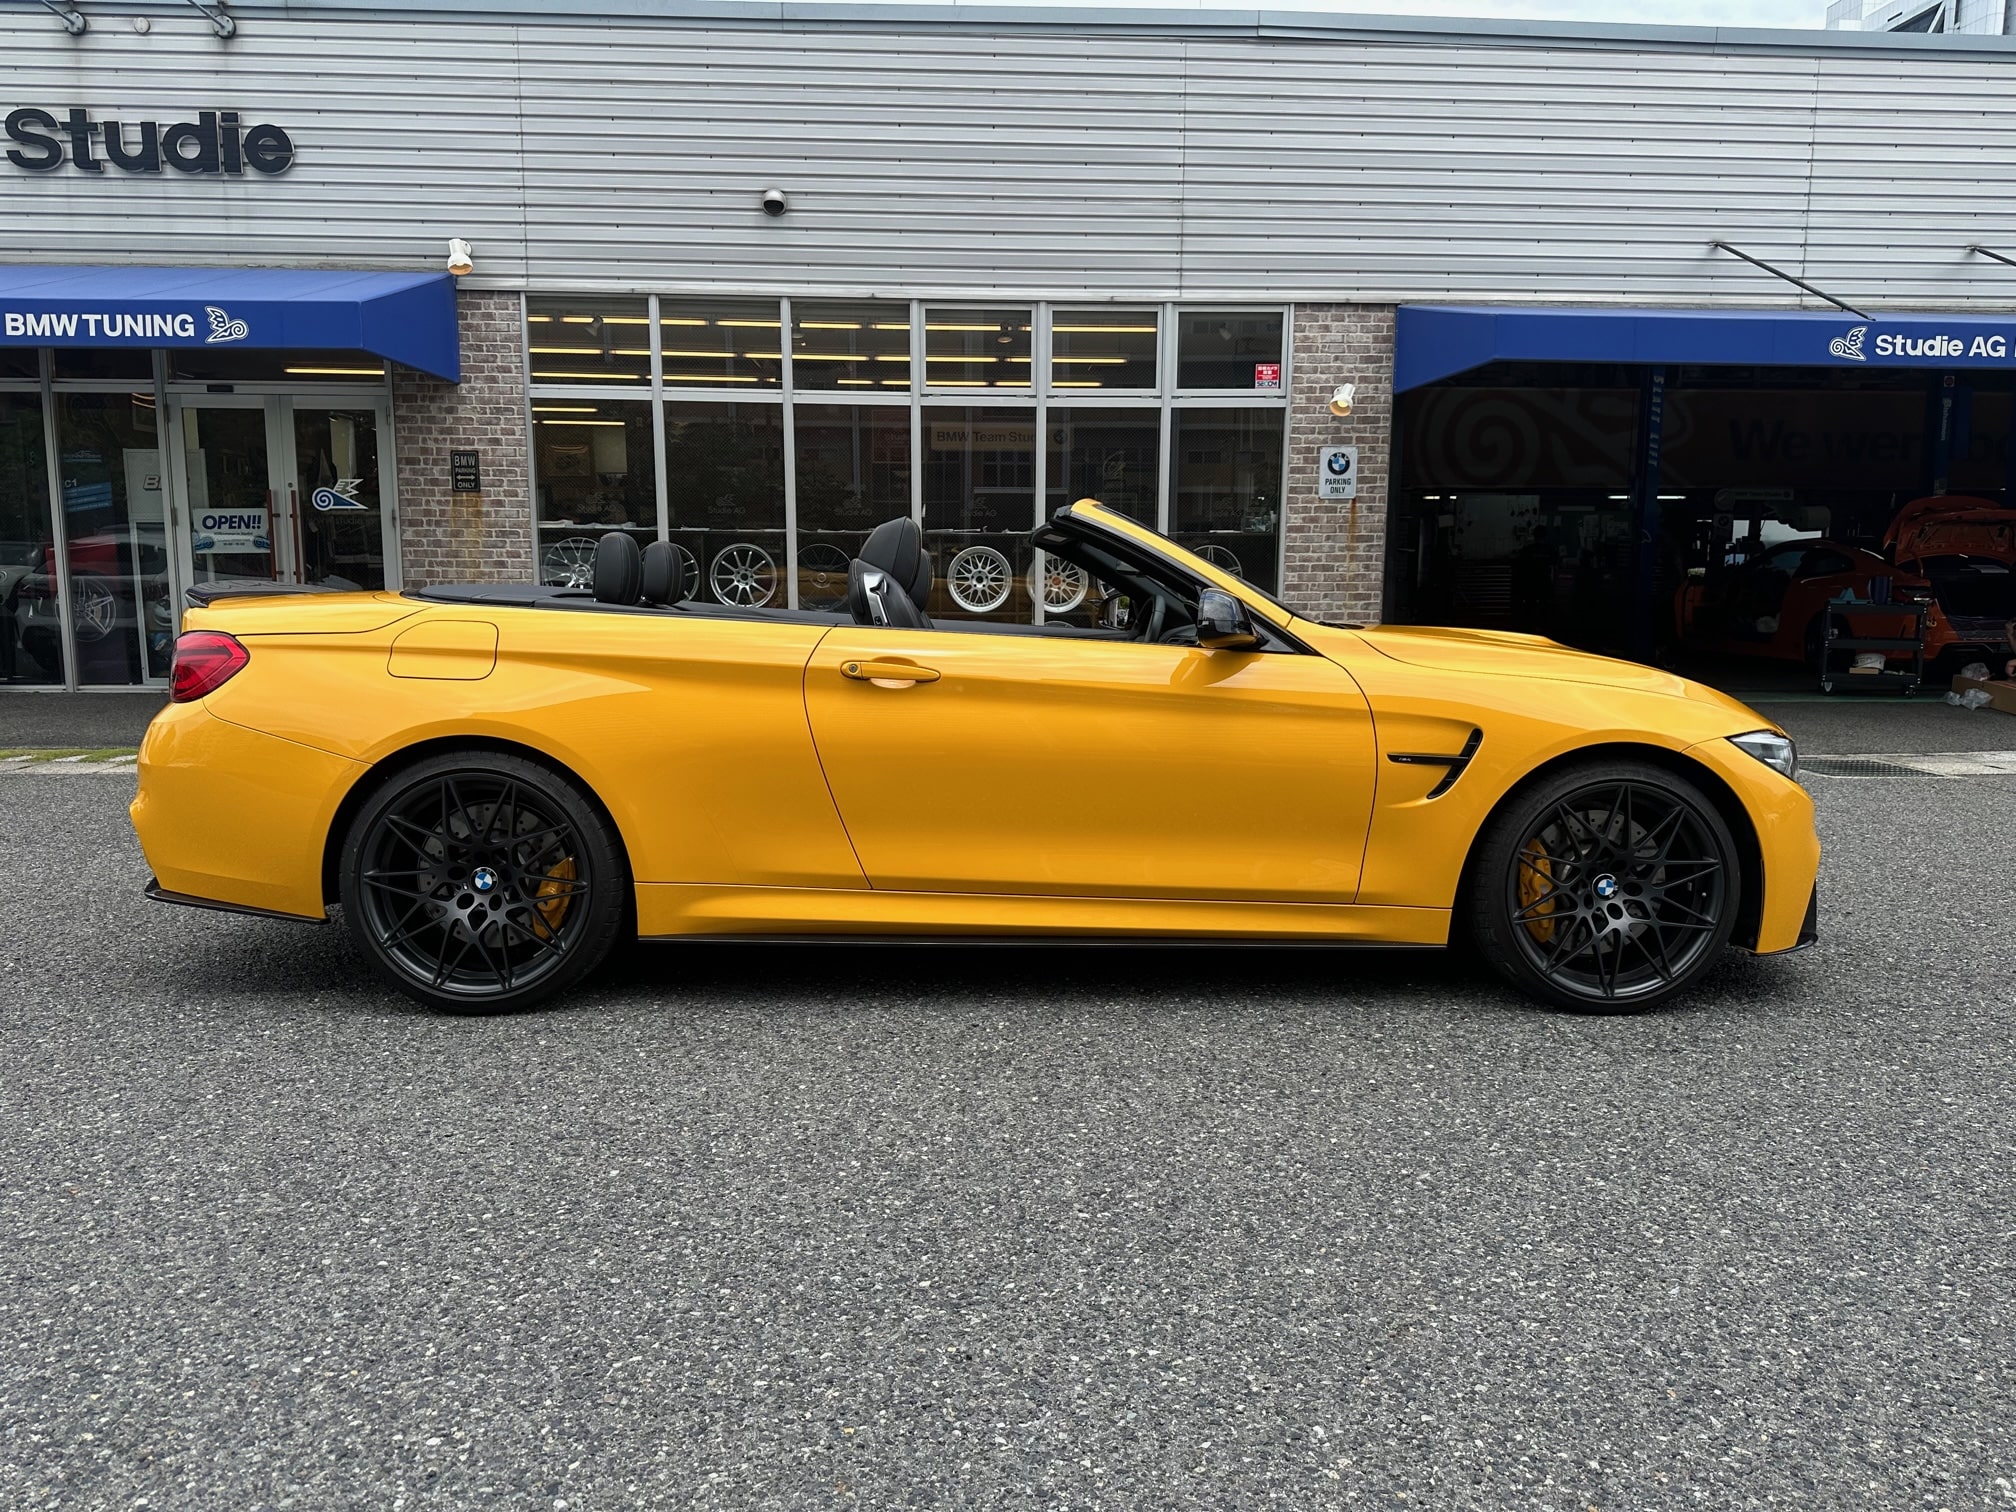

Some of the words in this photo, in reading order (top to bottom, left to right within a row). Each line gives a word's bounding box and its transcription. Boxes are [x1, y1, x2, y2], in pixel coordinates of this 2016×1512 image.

[4, 108, 295, 175] Studie
[5, 313, 78, 336] BMW
[82, 314, 195, 337] TUNING
[1875, 334, 1964, 356] Studie
[1968, 335, 2006, 357] AG
[1823, 431, 1925, 462] wer
[454, 455, 476, 466] BMW
[1330, 486, 1346, 494] ONLY
[202, 514, 262, 530] OPEN!!
